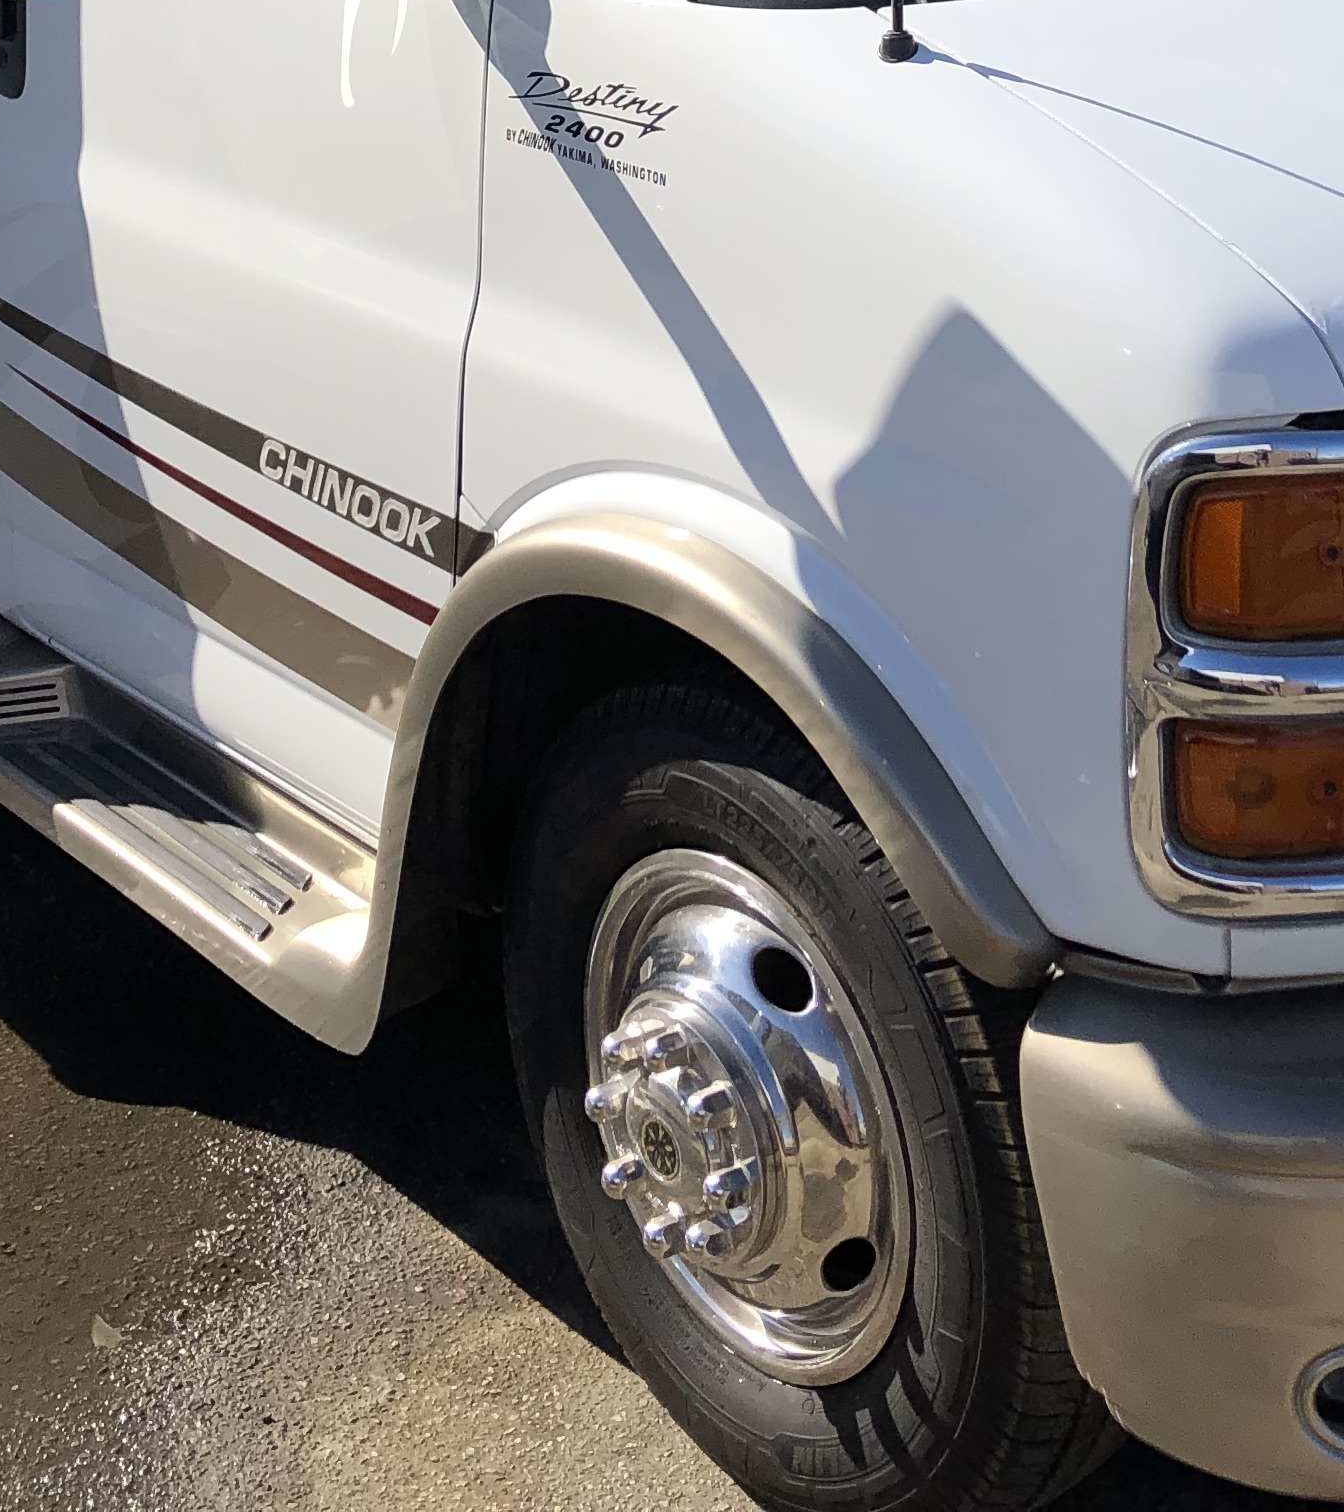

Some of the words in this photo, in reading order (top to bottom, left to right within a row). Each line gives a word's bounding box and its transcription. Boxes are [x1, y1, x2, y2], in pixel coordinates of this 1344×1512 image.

[507, 71, 680, 140] Destiny
[543, 114, 625, 149] 2400
[505, 128, 517, 143] BY
[517, 128, 558, 154] CHINOOK
[600, 155, 667, 187] WASHINGTON
[258, 438, 442, 558] CHINOOK
